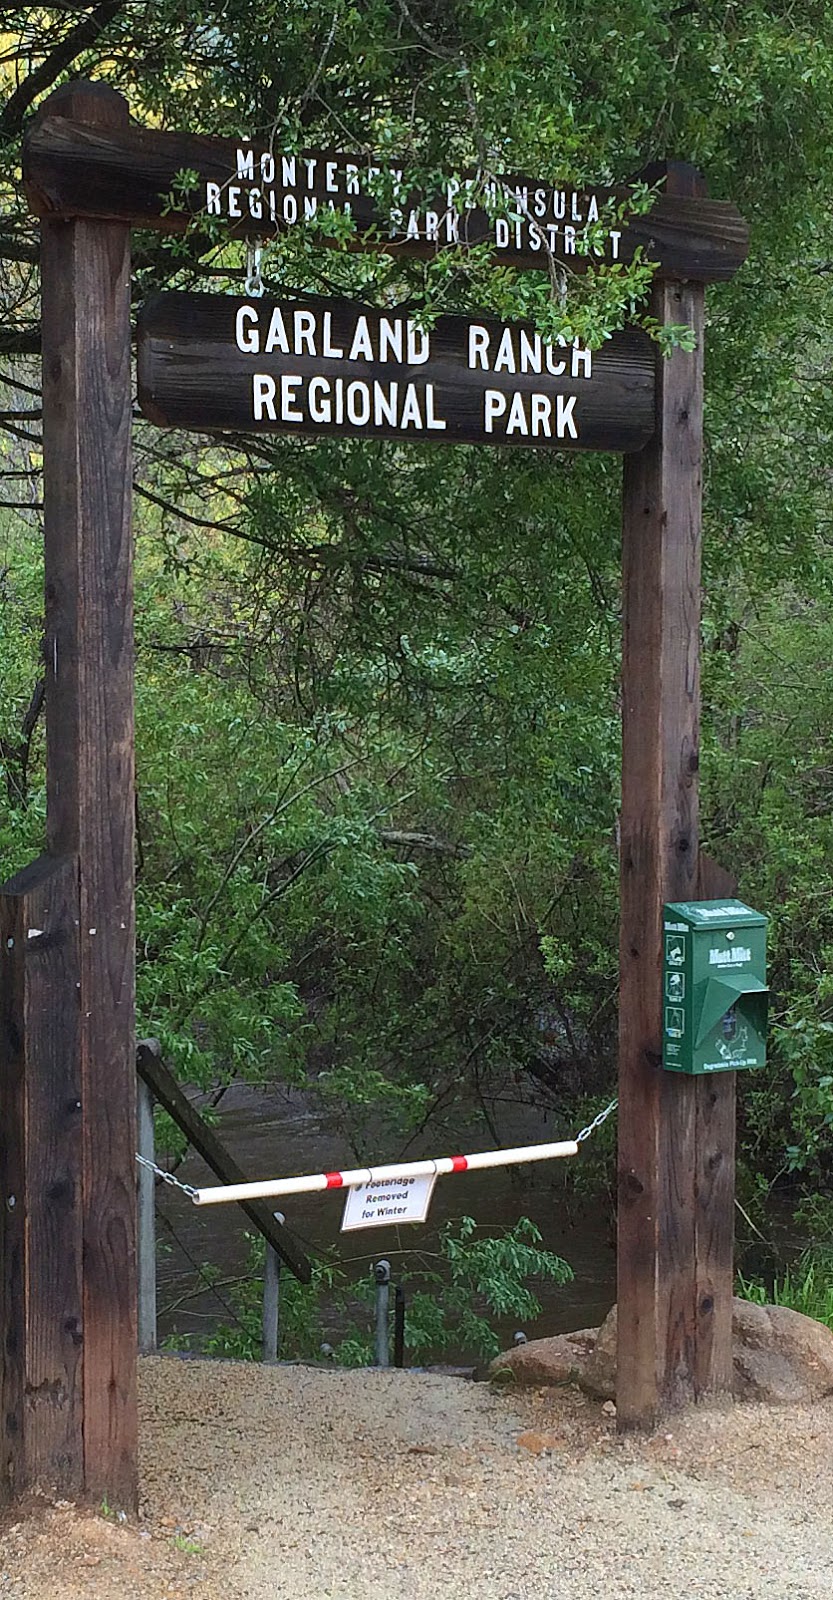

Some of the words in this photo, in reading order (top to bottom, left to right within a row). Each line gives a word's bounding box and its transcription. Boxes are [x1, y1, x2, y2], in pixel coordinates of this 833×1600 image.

[390, 207, 460, 244] PARK
[495, 219, 622, 260] DISTRIT
[235, 305, 431, 365] GARLAND
[468, 325, 593, 379] RANCH
[252, 374, 447, 430] REGIONAL
[484, 389, 579, 439] PARK
[365, 1178, 415, 1189] Footbridge
[366, 1191, 408, 1203] Removed
[362, 1210, 375, 1219] for
[377, 1206, 407, 1216] Winter
